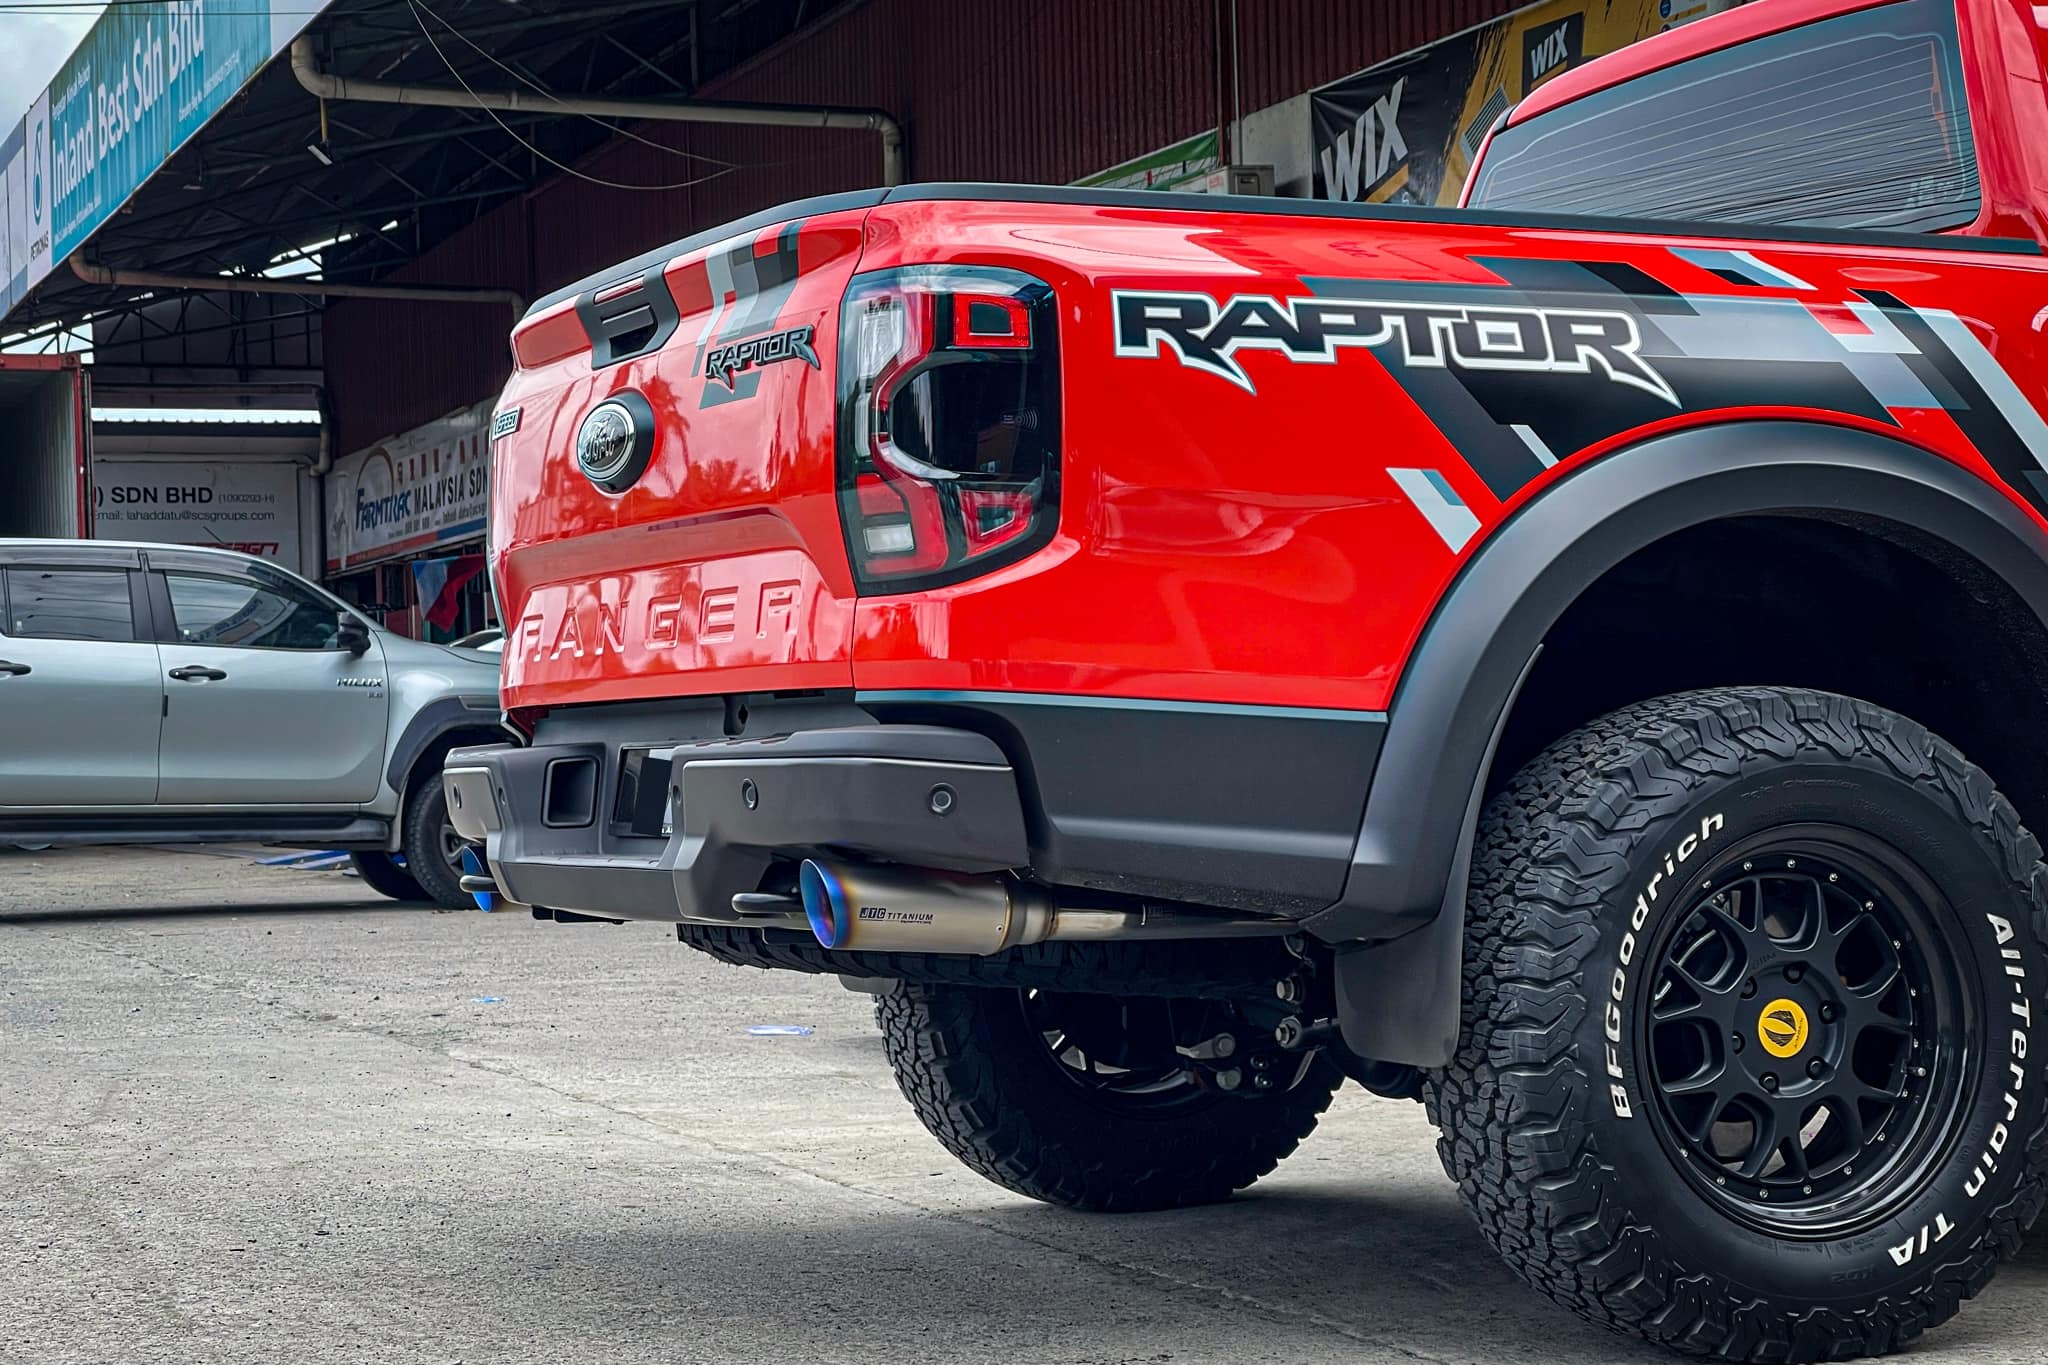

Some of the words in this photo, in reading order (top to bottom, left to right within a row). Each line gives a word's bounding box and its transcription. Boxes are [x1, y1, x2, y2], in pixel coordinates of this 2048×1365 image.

[1531, 22, 1568, 79] WIX
[52, 92, 95, 208] Inland
[98, 62, 131, 160] Best
[133, 19, 164, 122] Sdn
[168, 0, 205, 84] Bhd
[1321, 75, 1408, 201] WIX
[705, 325, 821, 390] RAPTOR
[1111, 288, 1682, 409] RAPTOR
[111, 486, 157, 504] SDN
[166, 486, 213, 504] BHD
[414, 472, 465, 514] MALAYSIA
[520, 579, 802, 664] RANGER
[336, 677, 383, 688] HILUX
[887, 912, 934, 921] TITANIUM
[1605, 812, 1725, 1119] BFGoodrich
[1964, 912, 2033, 1199] All-Terrain
[1887, 1212, 1957, 1267] T/A
